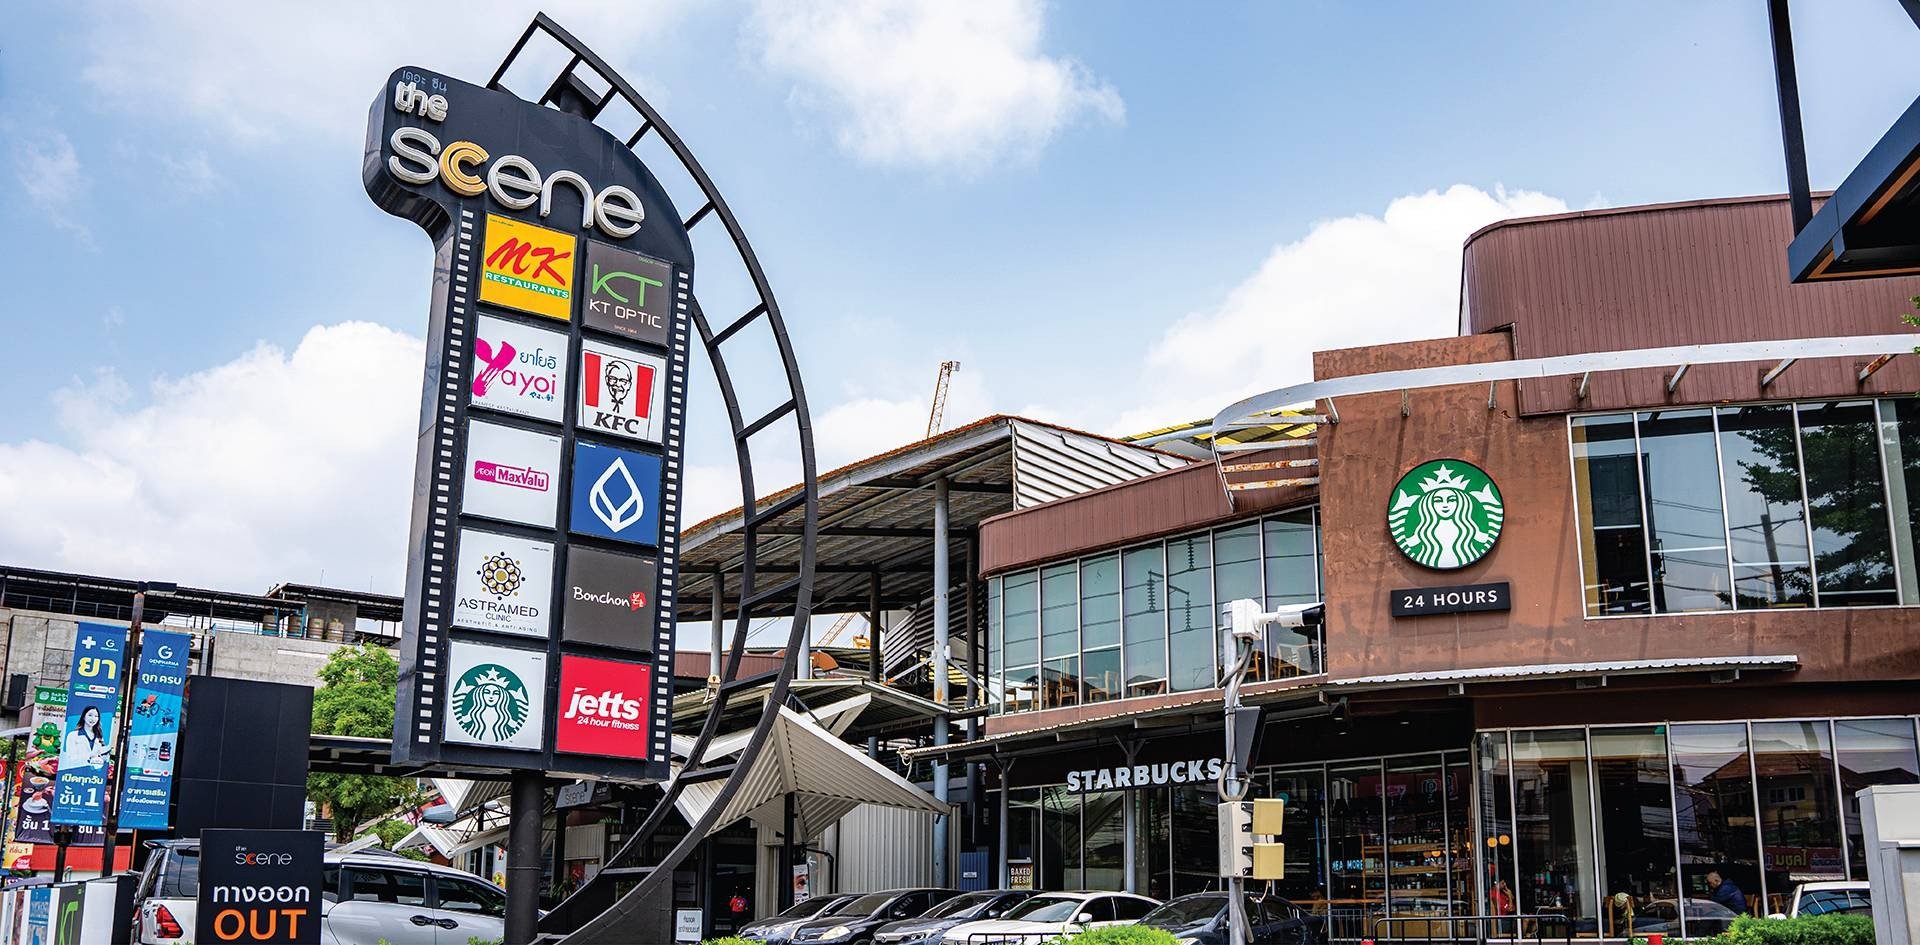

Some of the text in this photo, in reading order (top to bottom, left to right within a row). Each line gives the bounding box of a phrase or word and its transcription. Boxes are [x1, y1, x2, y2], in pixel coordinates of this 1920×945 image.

[402, 70, 426, 85] เดอะ
[394, 80, 449, 122] the
[388, 126, 646, 239] scene
[486, 237, 571, 287] MK
[485, 271, 569, 299] RESTAURANTS
[592, 263, 663, 307] KT
[589, 298, 662, 330] KT OPTIC
[519, 347, 557, 370] ยาโยอิ
[593, 411, 640, 435] KFC
[498, 467, 545, 488] MaxValu
[573, 586, 630, 607] Bonchon
[1403, 590, 1498, 609] 24 HOURS
[458, 597, 539, 618] ASTRAMED
[485, 612, 512, 622] CLINIC
[78, 657, 117, 680] ยา
[142, 673, 182, 686] ถูก ครบ
[564, 687, 641, 721] jetts
[577, 716, 640, 731] 24 hour fitness
[61, 773, 104, 787] เปิดทุกวัน
[1067, 758, 1222, 792] STARBUCKS
[59, 785, 99, 807] ชั้น 1
[22, 815, 50, 831] ชั้น 1
[235, 852, 292, 865] scene
[1010, 876, 1031, 884] FRESH
[213, 886, 310, 902] ทางออก
[214, 909, 307, 941] OUT
